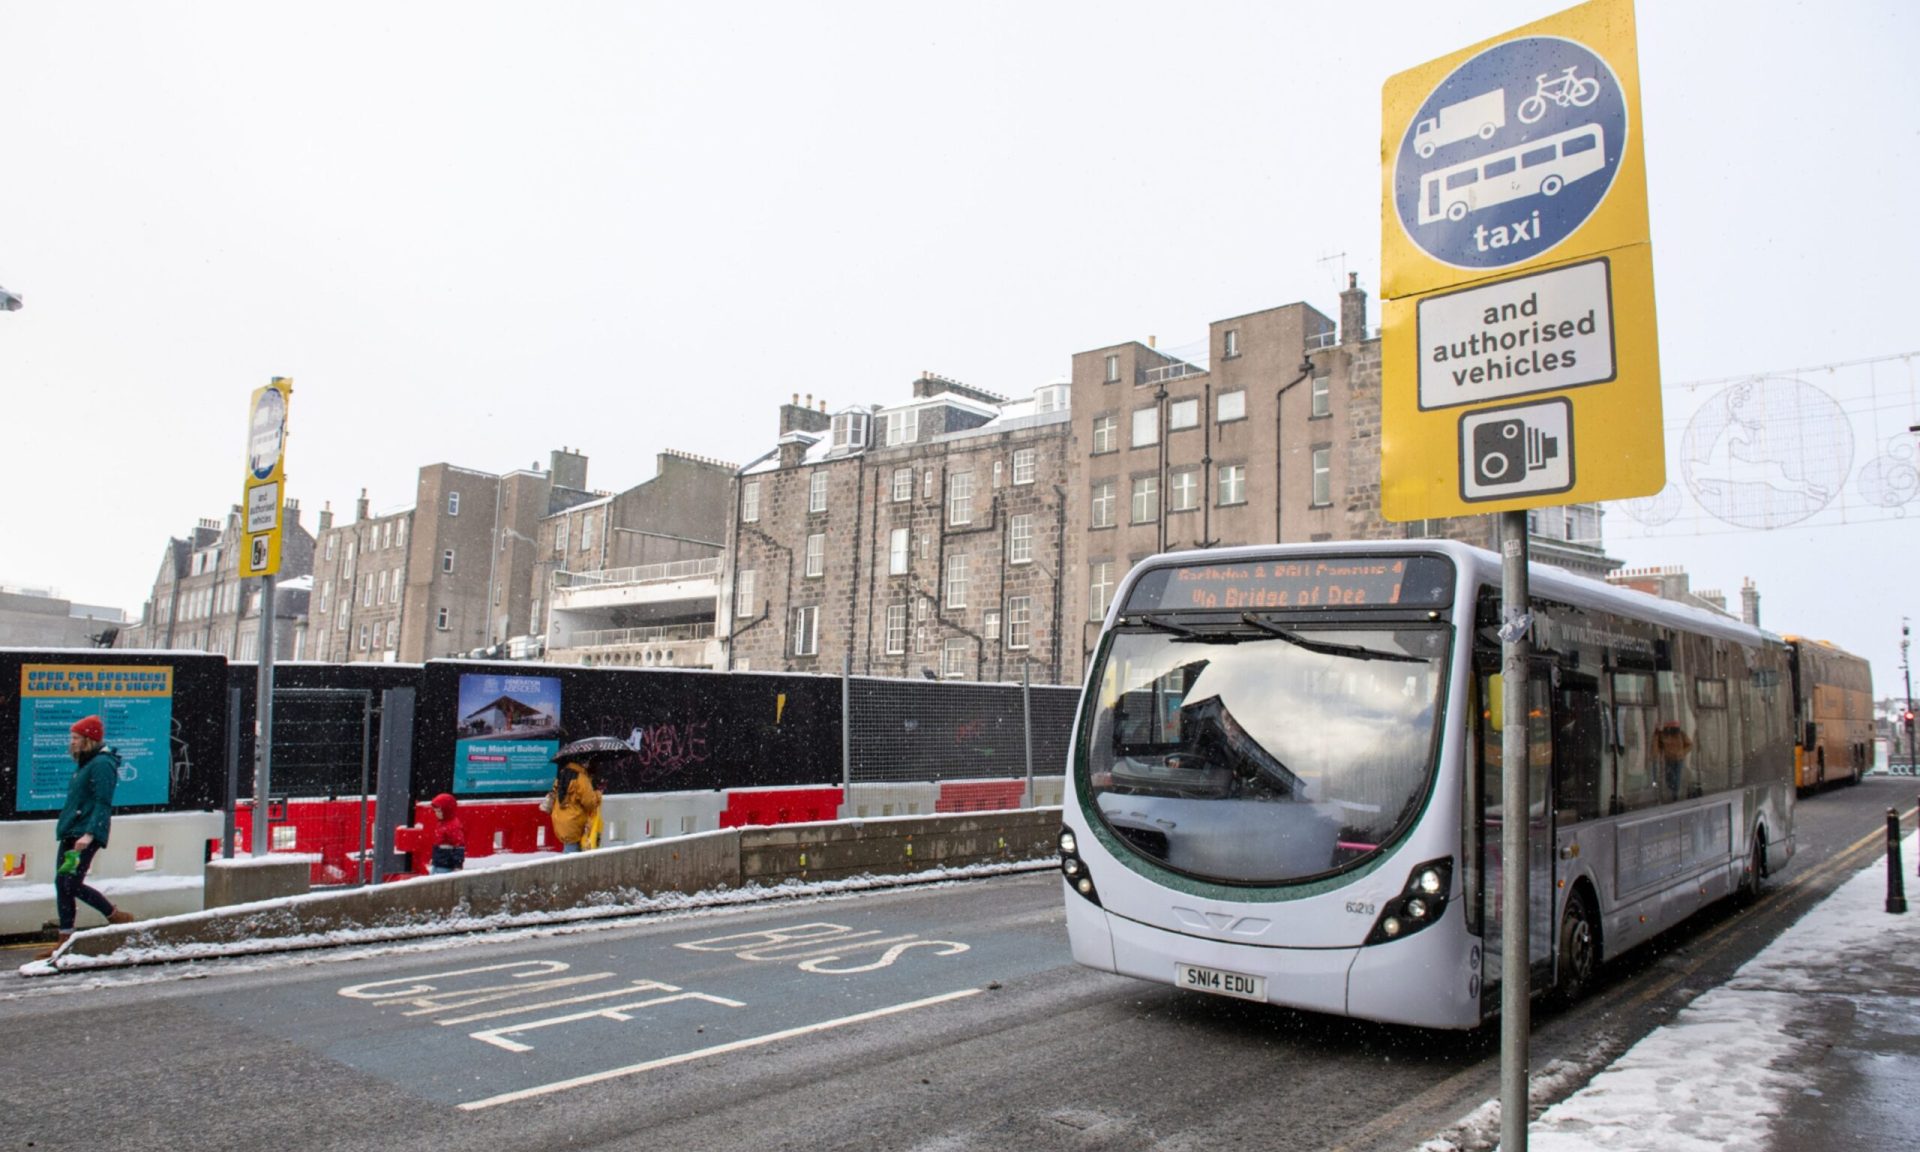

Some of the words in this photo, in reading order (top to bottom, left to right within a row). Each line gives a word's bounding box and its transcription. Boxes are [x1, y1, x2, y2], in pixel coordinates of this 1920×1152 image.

[1474, 211, 1541, 251] taxi
[1483, 293, 1538, 325] and
[1433, 310, 1596, 363] authorised
[1452, 349, 1577, 386] vehicles
[1225, 587, 1288, 607] Bridge
[1298, 586, 1320, 604] of
[1328, 585, 1366, 604] Dee
[28, 671, 64, 681] OPEN
[68, 672, 93, 681] FOR
[78, 682, 111, 691] PUBS
[126, 682, 166, 691] SHOPS
[503, 685, 541, 693] ABERDEEN
[468, 744, 486, 753] New
[488, 744, 515, 753] Market
[517, 744, 548, 754] Building
[674, 922, 971, 975] BUS
[1188, 968, 1220, 988] SN14
[1225, 975, 1254, 994] EDU
[336, 959, 747, 1053] GATE
